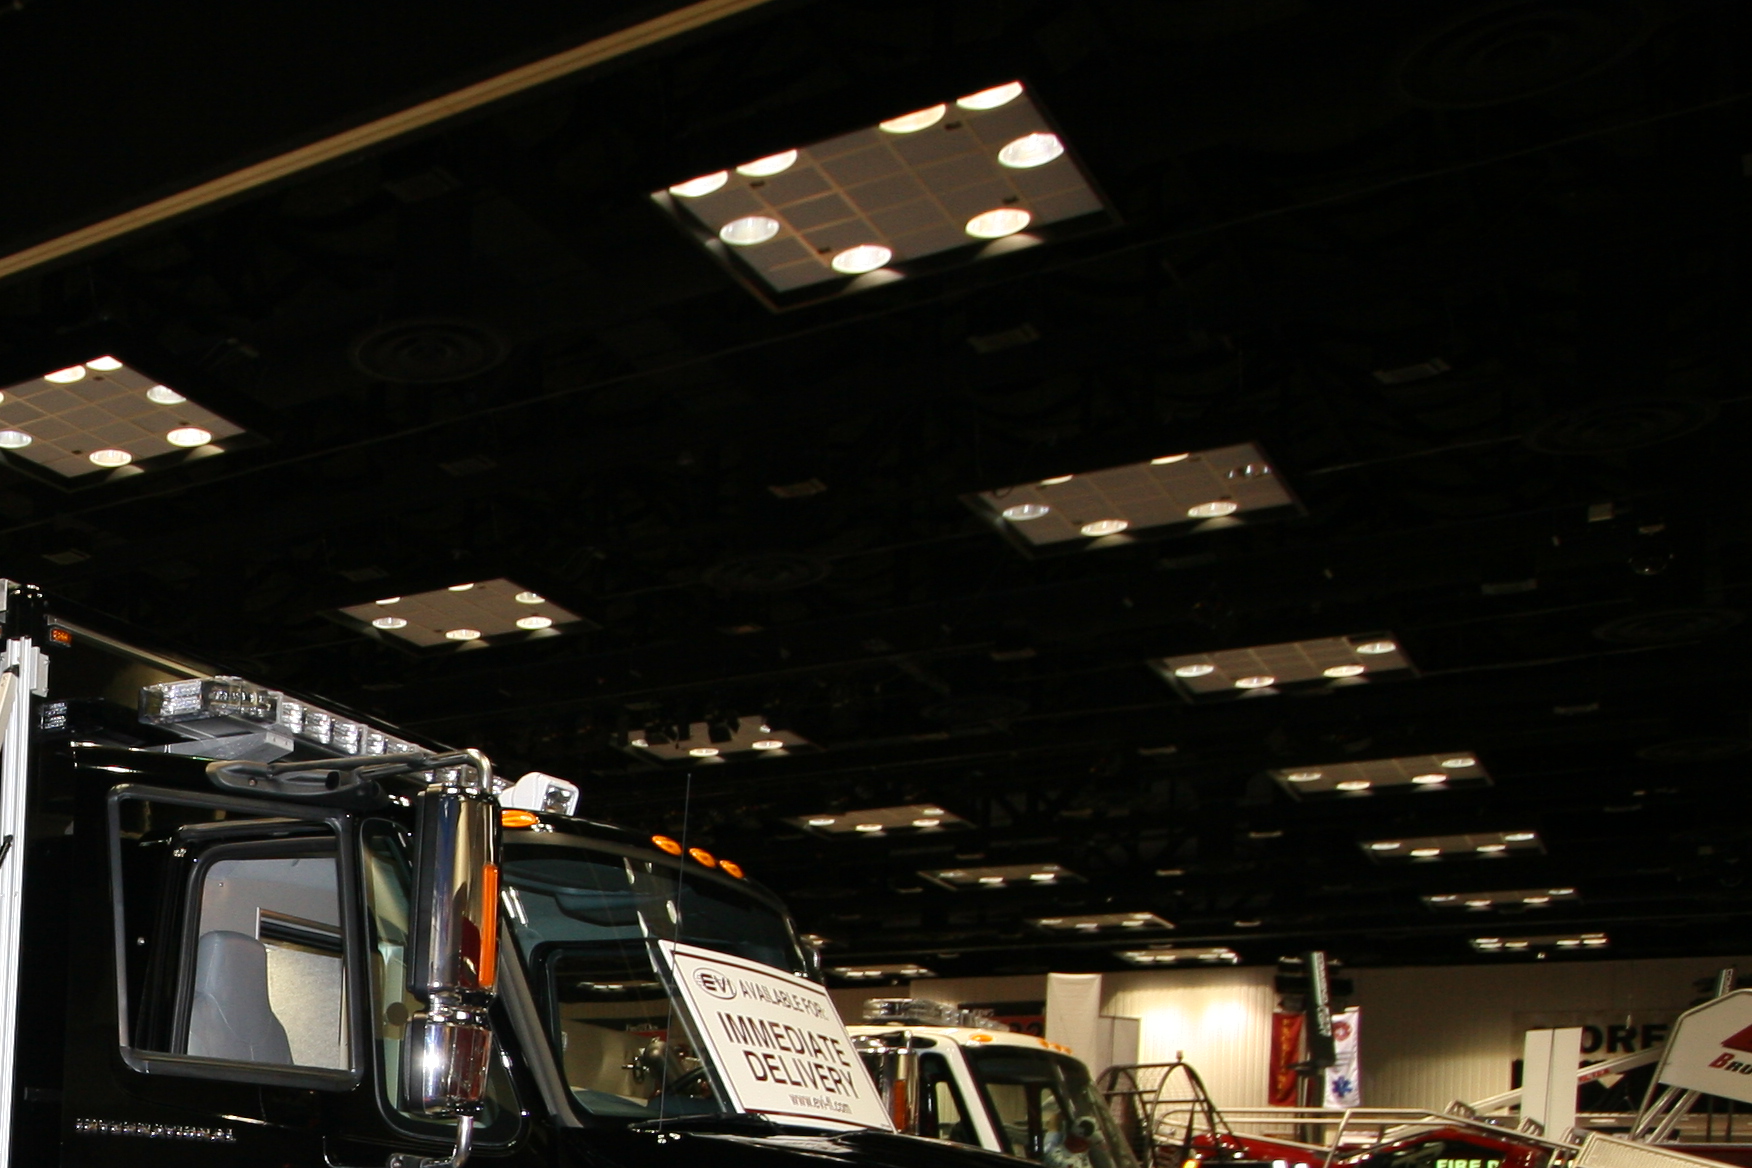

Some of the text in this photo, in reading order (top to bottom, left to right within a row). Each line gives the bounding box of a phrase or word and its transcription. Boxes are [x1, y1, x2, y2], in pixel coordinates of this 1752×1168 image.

[739, 979, 804, 1013] AVAILABLE
[716, 1010, 851, 1068] IMMEDIATE
[743, 1050, 859, 1099] DELIVERY
